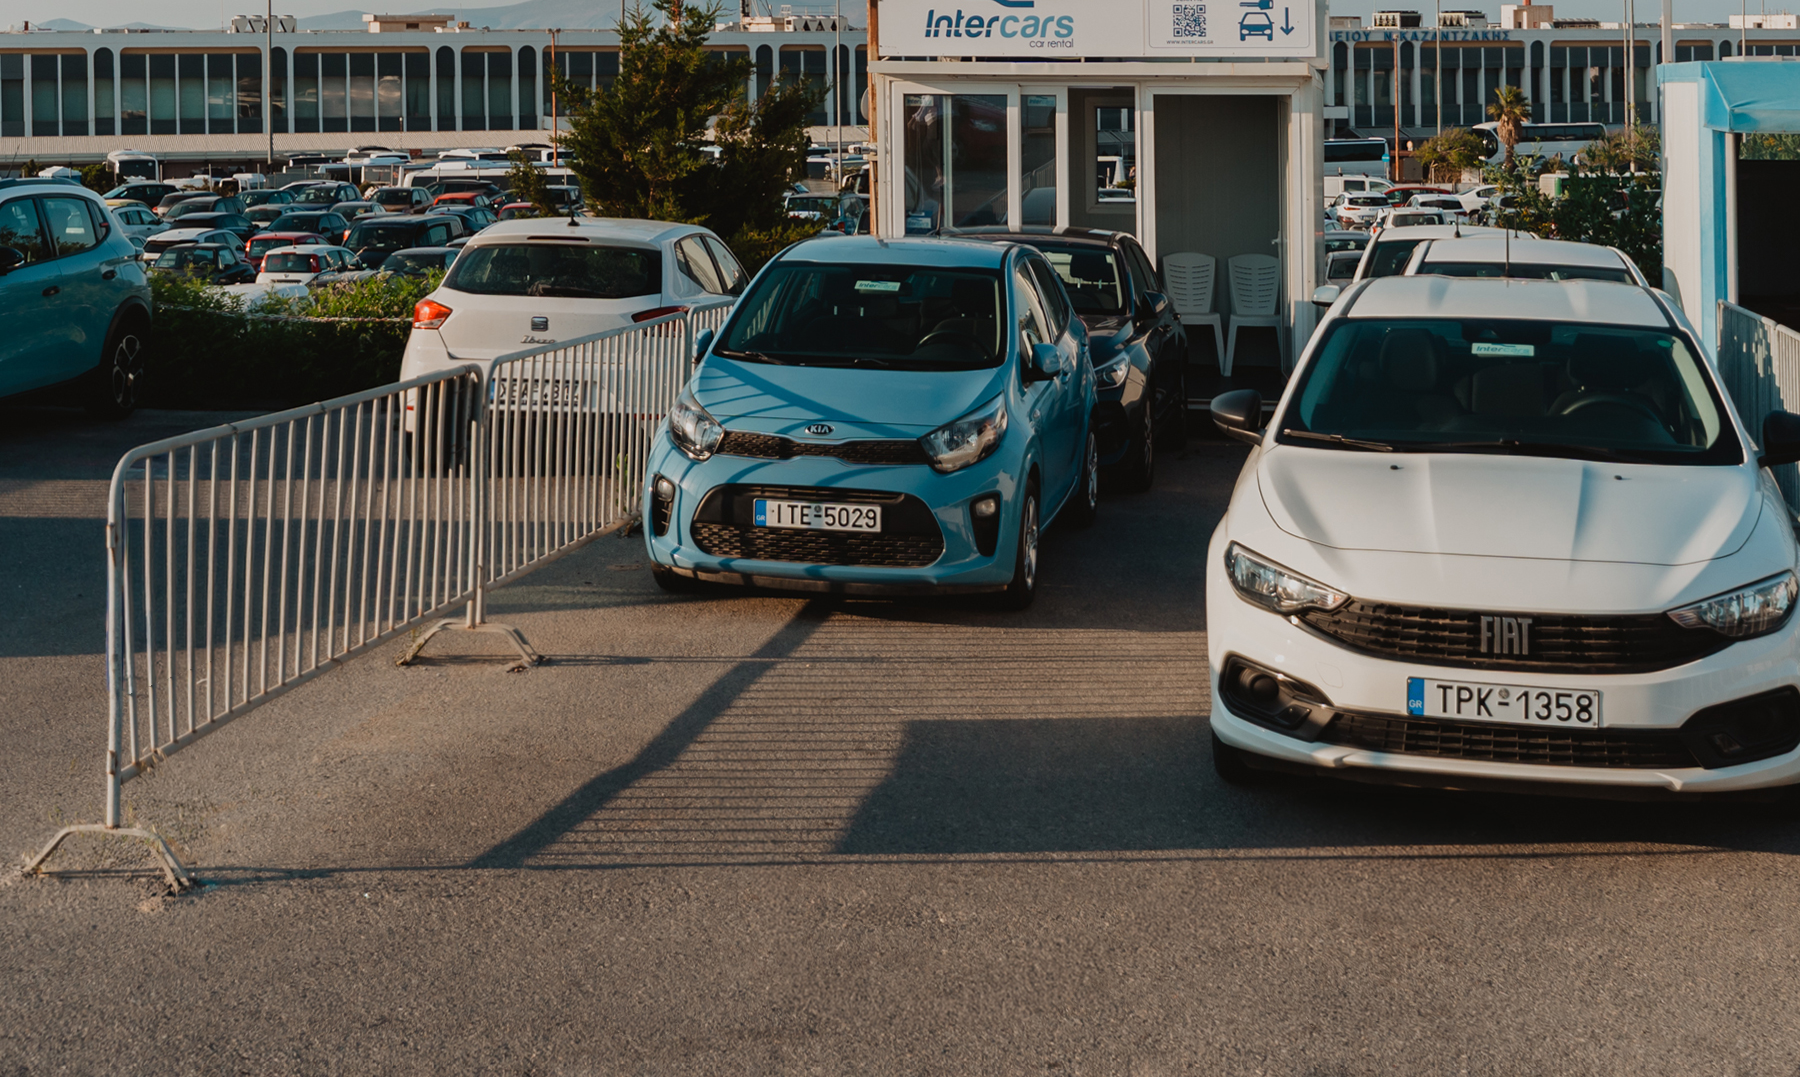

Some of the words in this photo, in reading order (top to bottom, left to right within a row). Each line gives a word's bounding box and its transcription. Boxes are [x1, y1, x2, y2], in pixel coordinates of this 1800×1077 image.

[925, 9, 1074, 38] Intercars
[1029, 40, 1045, 48] car
[1047, 39, 1074, 48] rental
[810, 425, 830, 434] KIA
[1480, 615, 1533, 655] FIAT
[1409, 699, 1423, 709] GR
